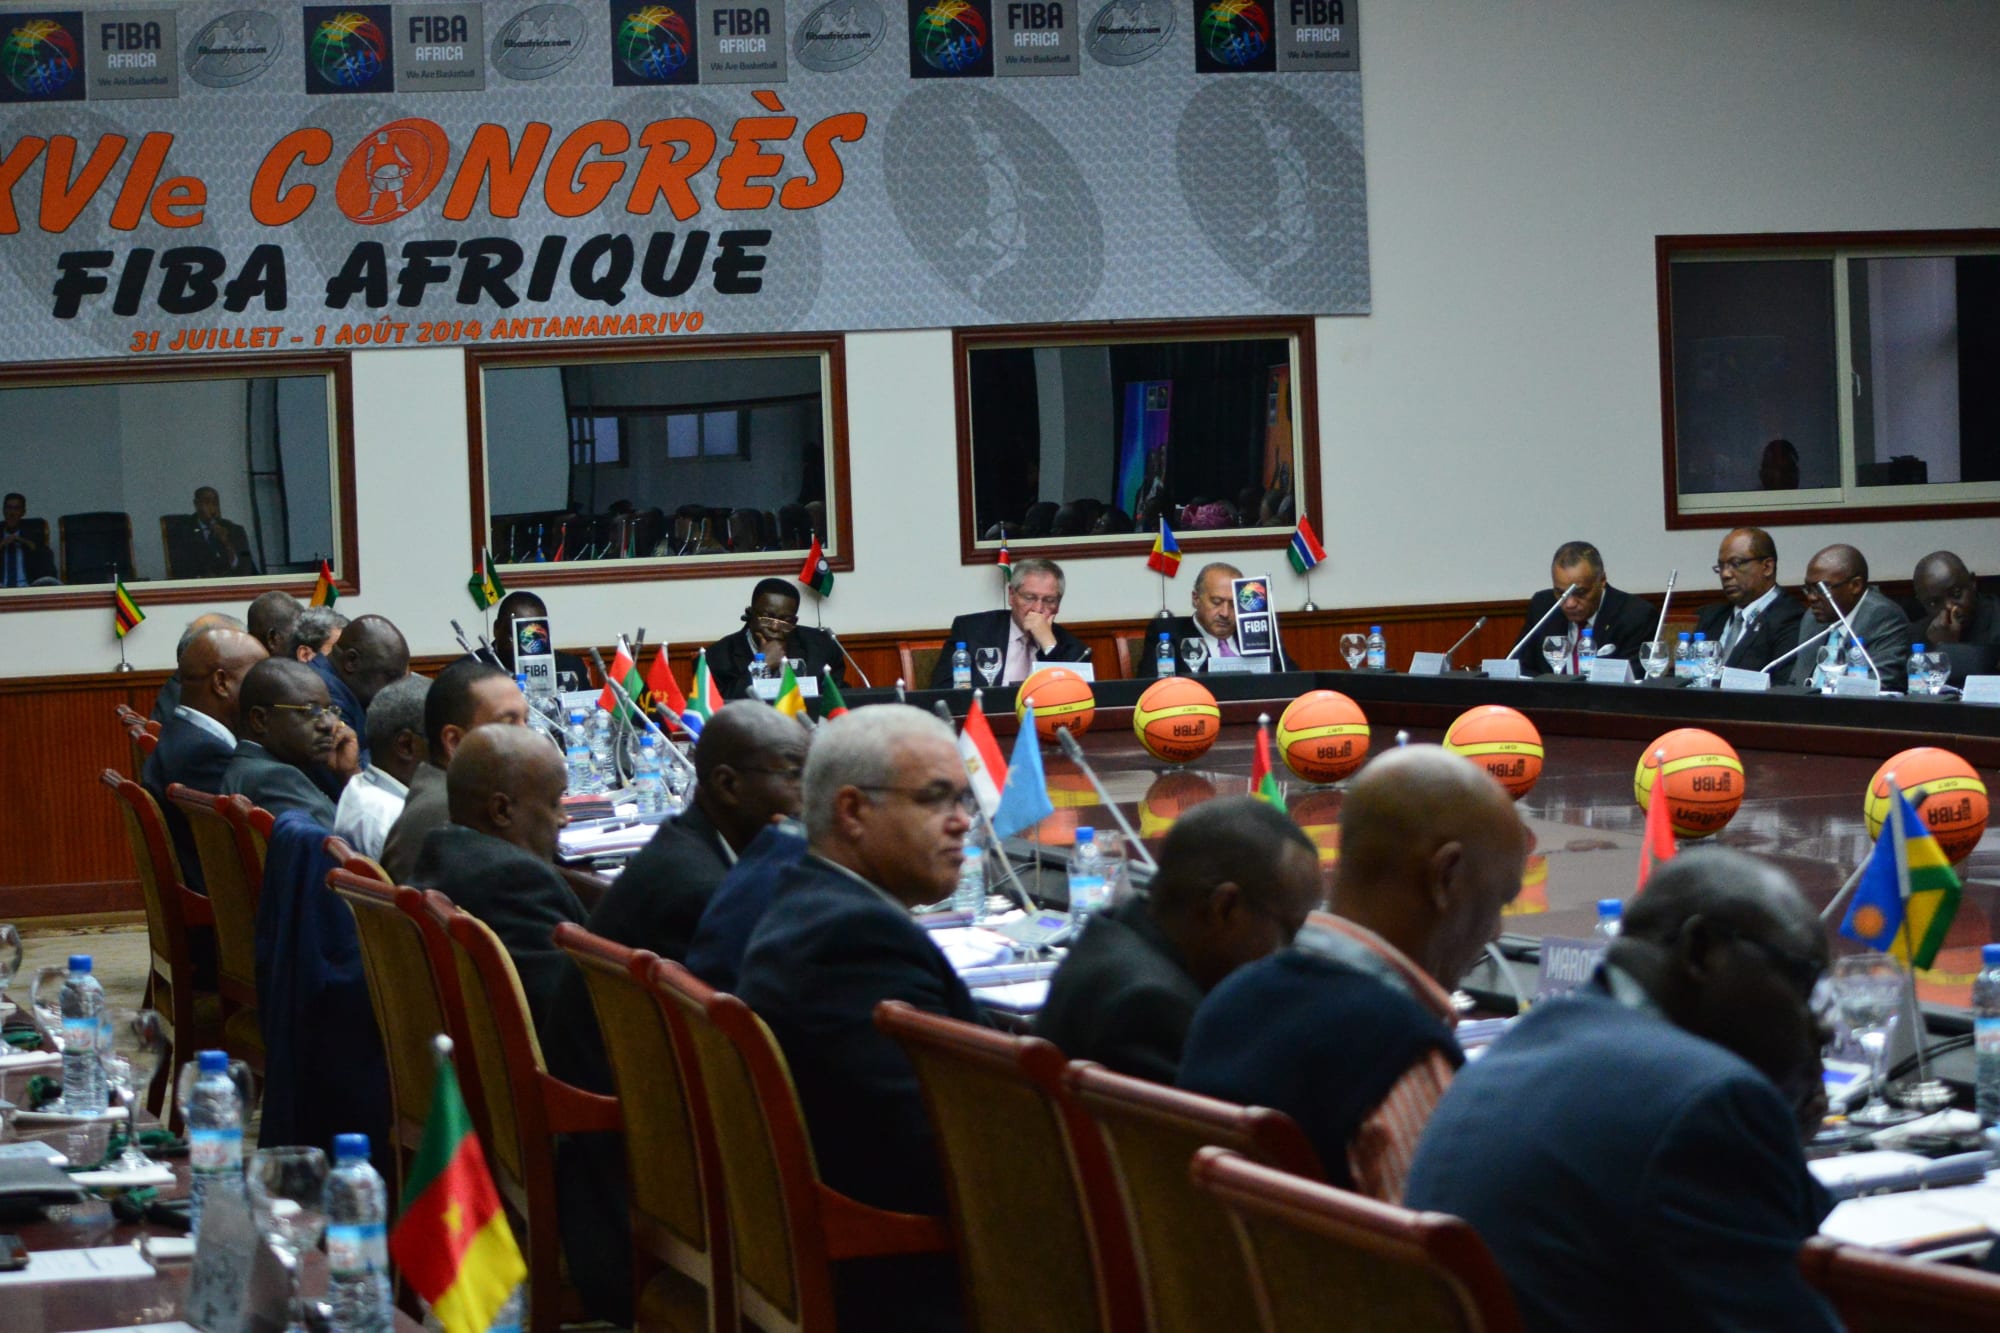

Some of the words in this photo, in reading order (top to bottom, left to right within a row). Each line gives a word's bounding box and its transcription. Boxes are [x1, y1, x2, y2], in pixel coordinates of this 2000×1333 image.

[1008, 3, 1063, 30] FIBA
[1290, 0, 1343, 25] FIBA
[409, 15, 467, 43] FIBA
[713, 8, 771, 36] FIBA
[101, 22, 161, 50] FIBA
[806, 32, 871, 40] fibaafrica.com
[1014, 32, 1059, 47] AFRICA
[1296, 28, 1340, 42] AFRICA
[504, 39, 571, 48] fibaafrica.com
[719, 38, 766, 53] AFRICA
[108, 53, 157, 69] AFRICA
[416, 46, 464, 61] AFRICA
[710, 63, 723, 71] We
[725, 62, 738, 70] Are
[250, 90, 867, 226] CONGRÈS
[52, 244, 287, 318] FIBA
[325, 229, 772, 308] AFRIQUE
[129, 331, 160, 351] 31
[169, 326, 283, 350] JUILLET
[315, 325, 326, 346] 1
[335, 315, 409, 345] AOÛT
[416, 320, 482, 342] 2014
[490, 311, 704, 339] ANTANANARIVO
[1244, 620, 1268, 633] FIBA
[524, 664, 548, 677] FIBA
[1173, 724, 1197, 736] FIBA
[1317, 746, 1343, 759] FIBA
[1487, 763, 1515, 777] FIBA
[1693, 776, 1721, 792] FIBA
[1927, 804, 1962, 826] FIBA
